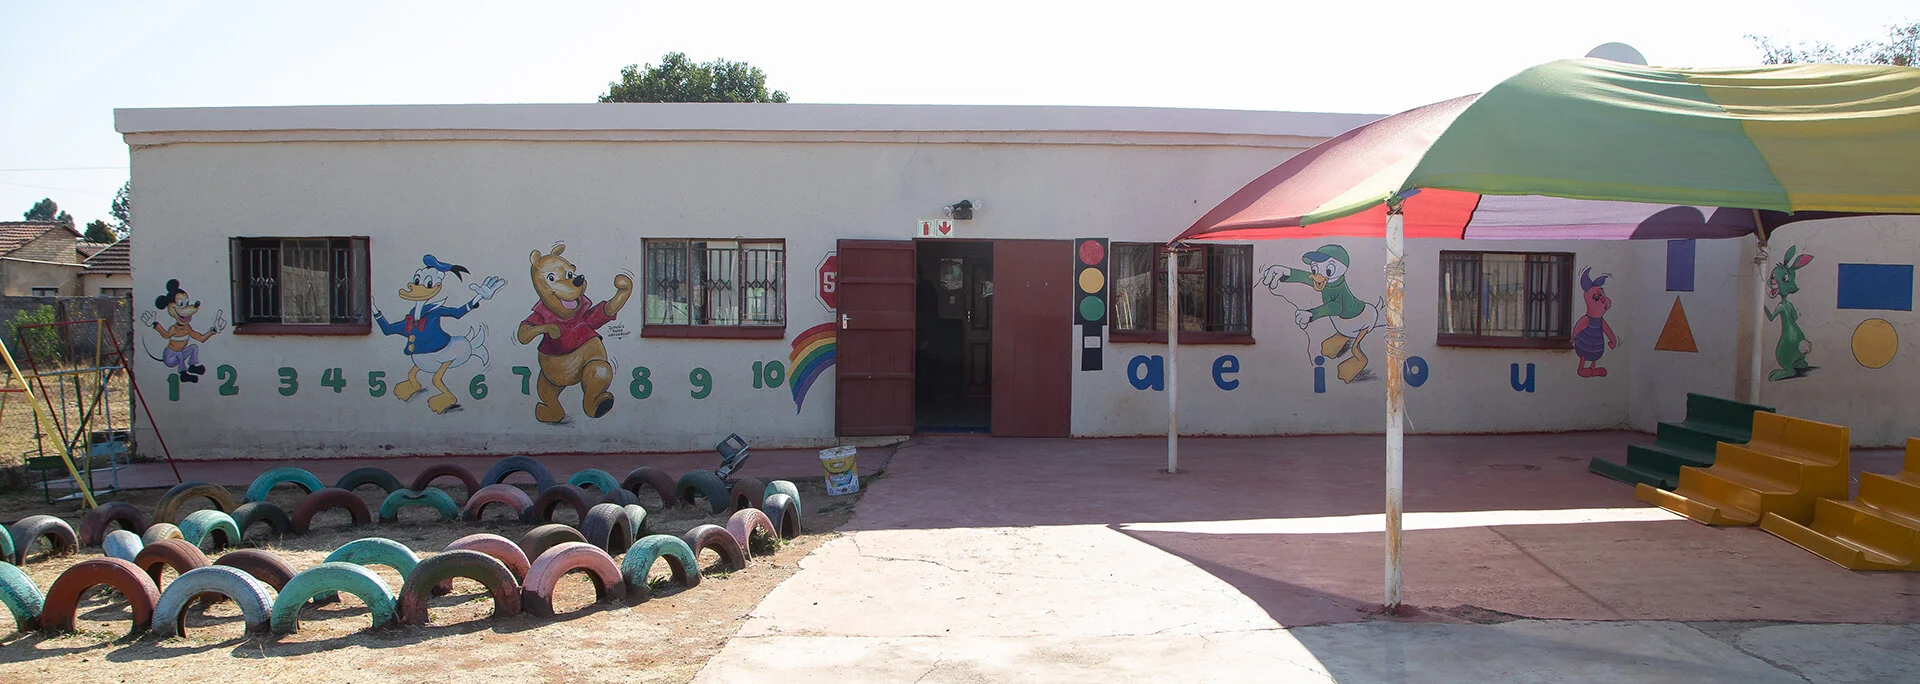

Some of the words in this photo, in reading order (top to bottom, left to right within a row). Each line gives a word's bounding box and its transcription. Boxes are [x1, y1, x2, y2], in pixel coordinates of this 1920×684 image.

[166, 373, 180, 402] 1
[216, 363, 239, 396] 2
[277, 366, 299, 397] 3
[320, 367, 347, 393] 4
[367, 370, 387, 398] 5
[468, 374, 488, 400] 6
[511, 365, 532, 396] 7
[629, 366, 653, 400] 8
[689, 367, 713, 400] 9
[751, 360, 786, 390] 10
[1126, 354, 1165, 392] a
[1211, 354, 1240, 391] e
[1314, 355, 1327, 393] i
[1403, 356, 1429, 388] o
[1510, 362, 1536, 393] u
